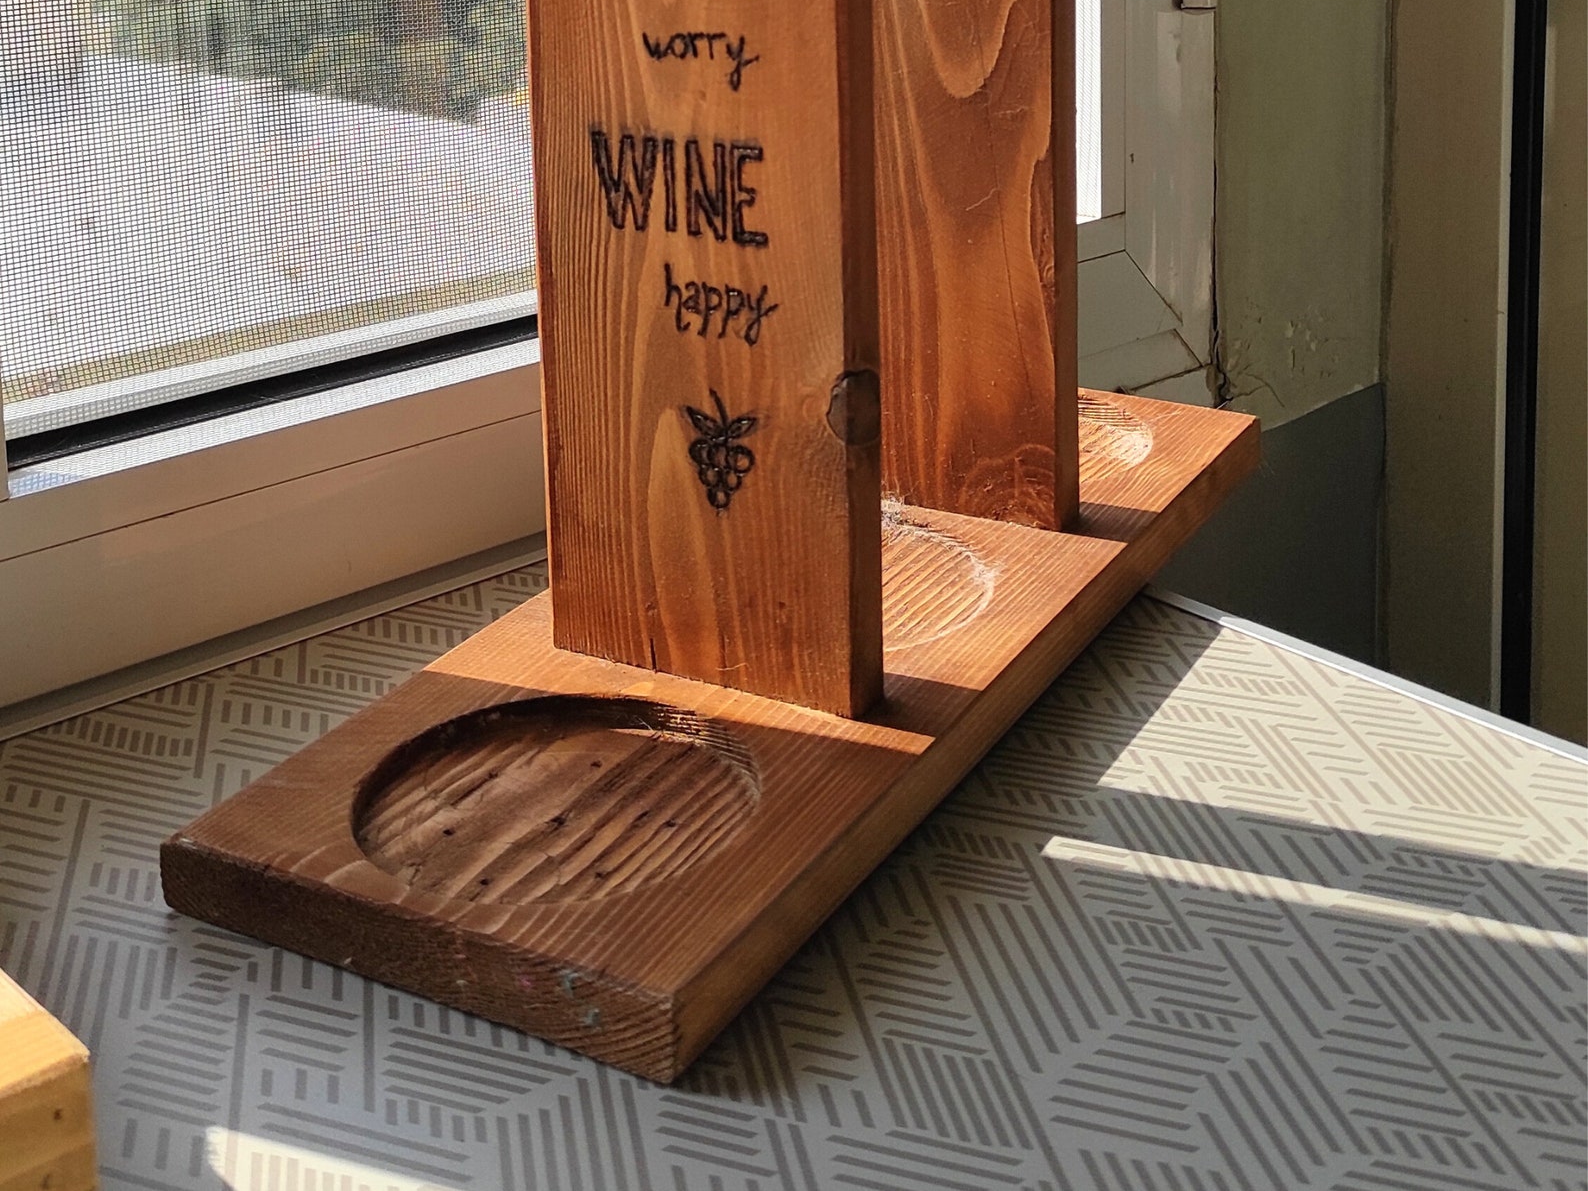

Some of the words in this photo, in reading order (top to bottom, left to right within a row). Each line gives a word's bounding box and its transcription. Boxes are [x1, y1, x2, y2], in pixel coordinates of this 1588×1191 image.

[642, 31, 760, 92] worry
[590, 128, 769, 246] WINE
[664, 262, 779, 346] happy
